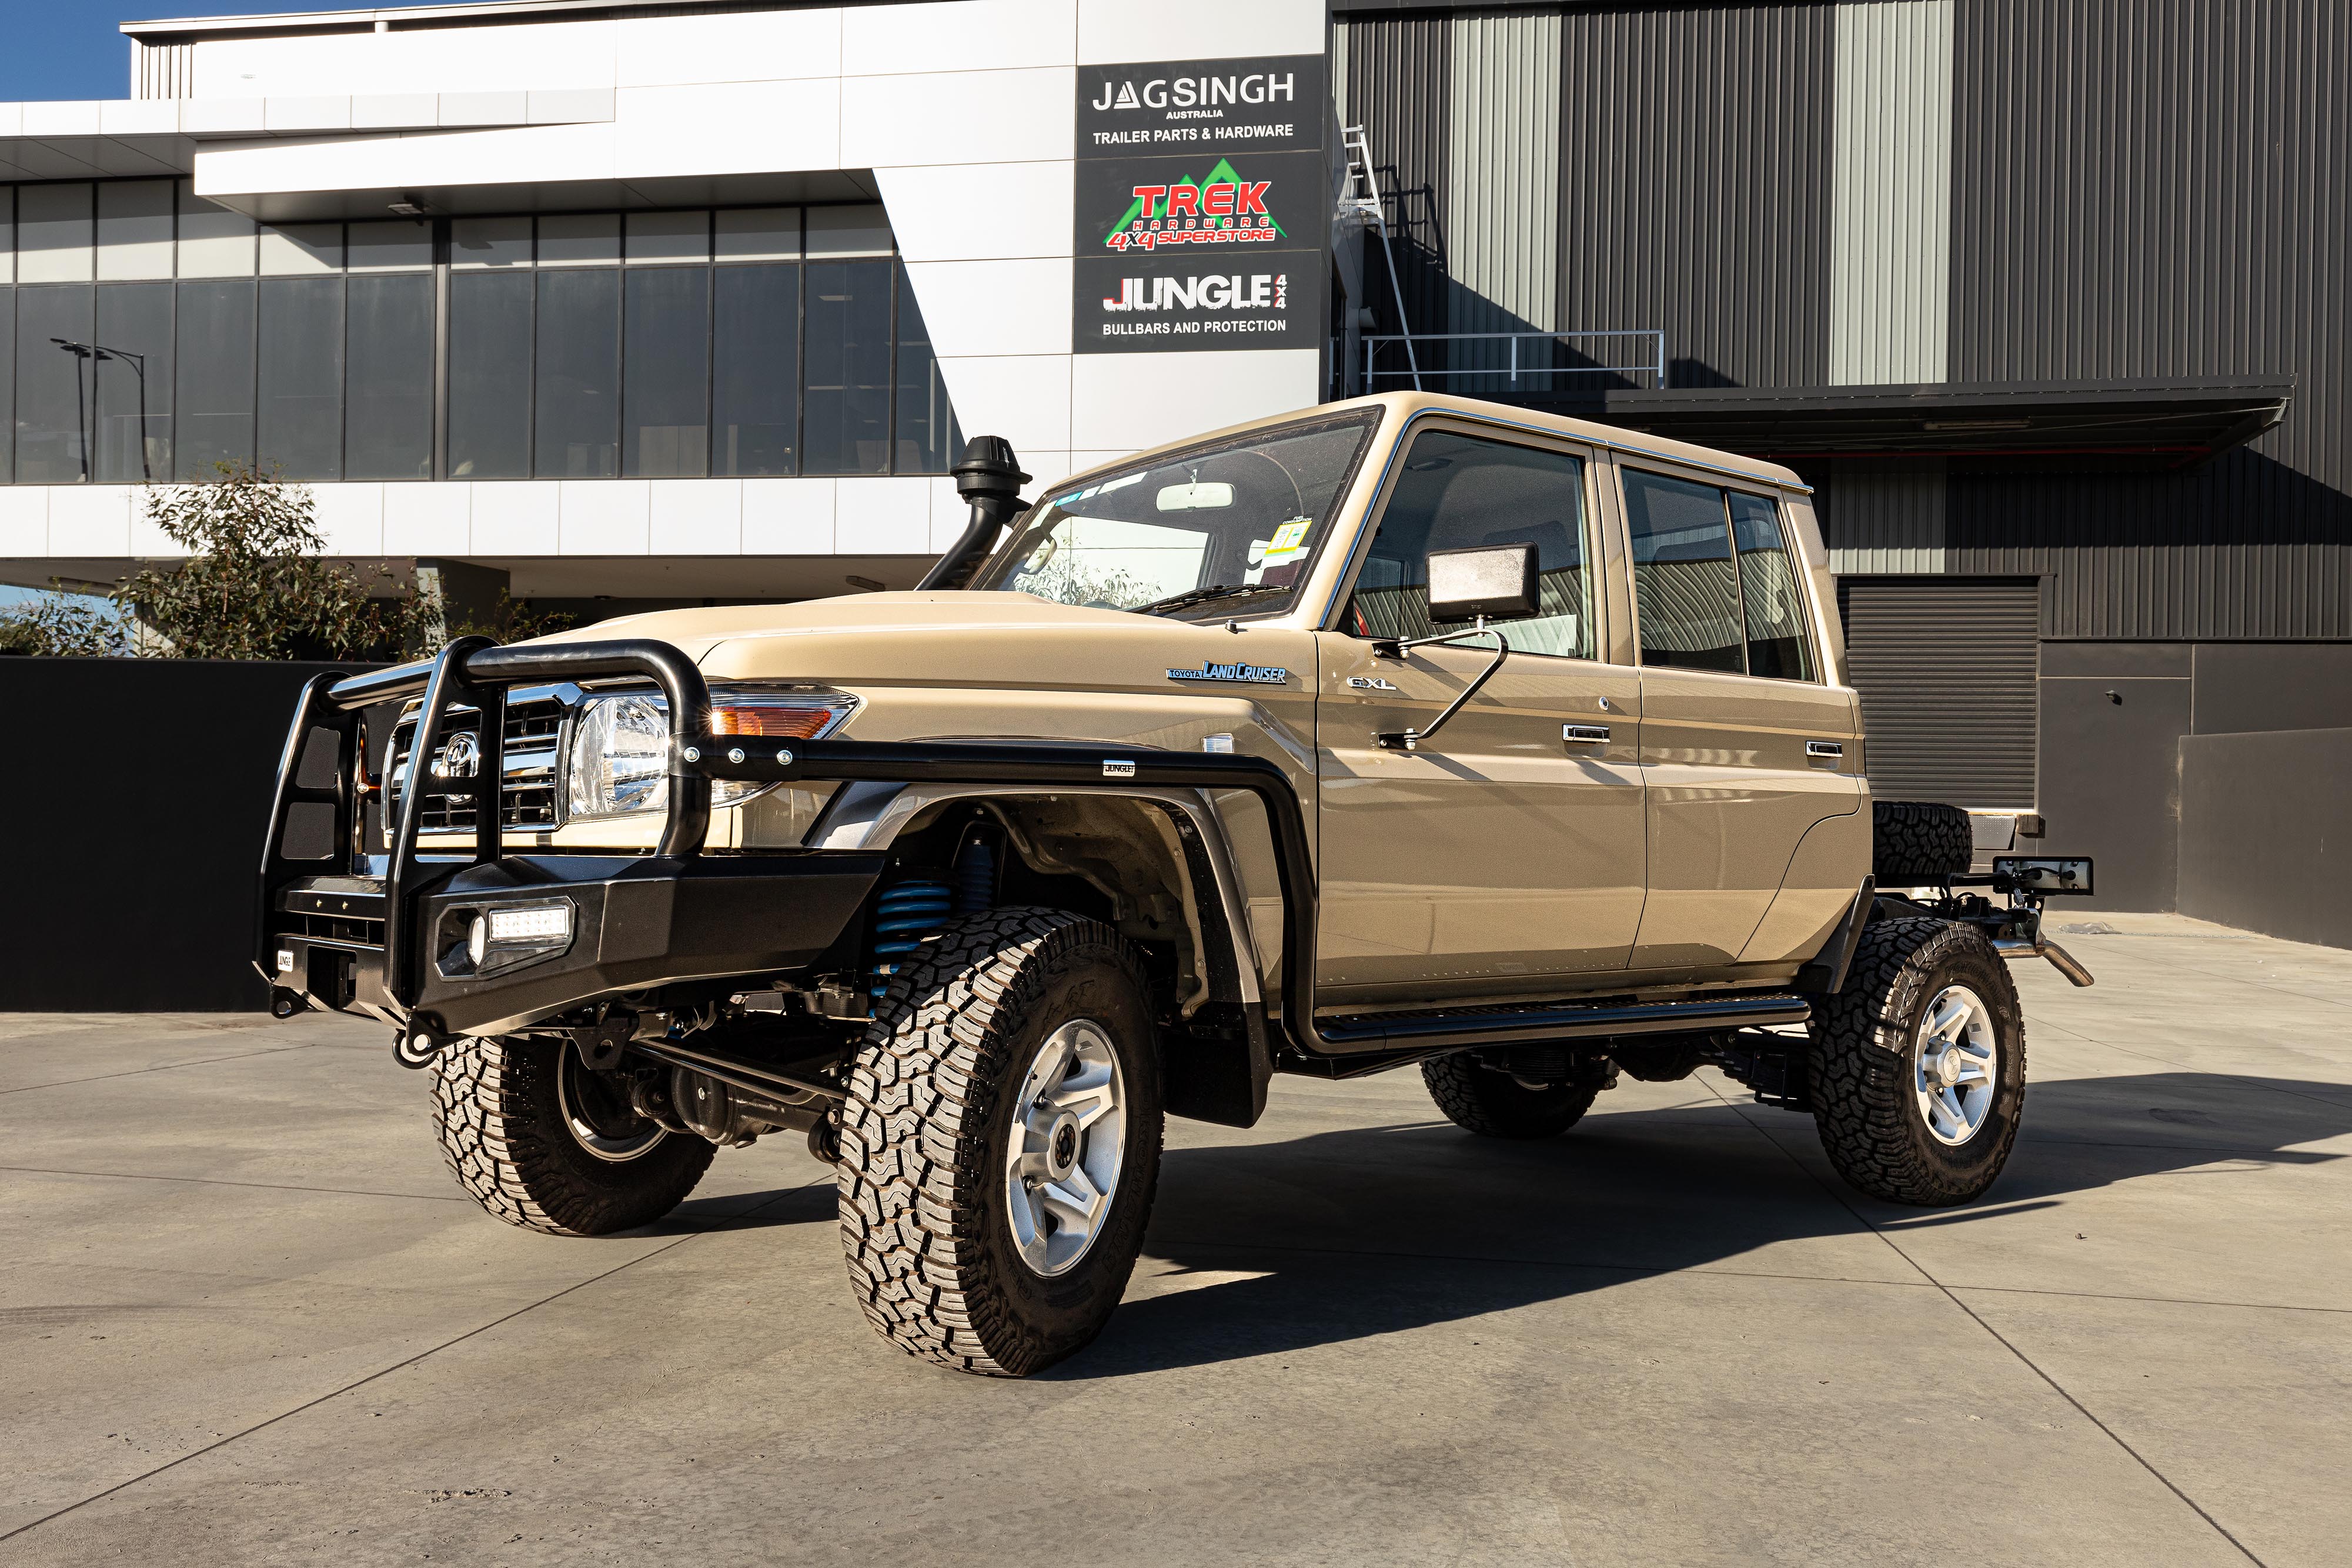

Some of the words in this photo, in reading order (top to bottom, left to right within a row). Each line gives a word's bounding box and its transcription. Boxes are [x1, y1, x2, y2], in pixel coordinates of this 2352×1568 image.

[1166, 109, 1224, 119] AUSTRALIA
[1093, 131, 1150, 145] TRAILER
[1154, 128, 1198, 142] PARTS
[1201, 127, 1211, 140] &
[1215, 124, 1294, 139] HARDWARE
[1132, 182, 1271, 218] TREK
[1132, 216, 1270, 231] HARDWARE
[1157, 228, 1275, 248] SUPERSTORE
[1103, 275, 1271, 313] JUNGLE
[1103, 323, 1170, 335] BULLBARS
[1173, 322, 1200, 333] AND
[1204, 320, 1286, 333] PROTECTION
[1170, 670, 1200, 678] TOYOTA
[1347, 676, 1396, 690] GXL
[1105, 764, 1131, 773] JUNGLE
